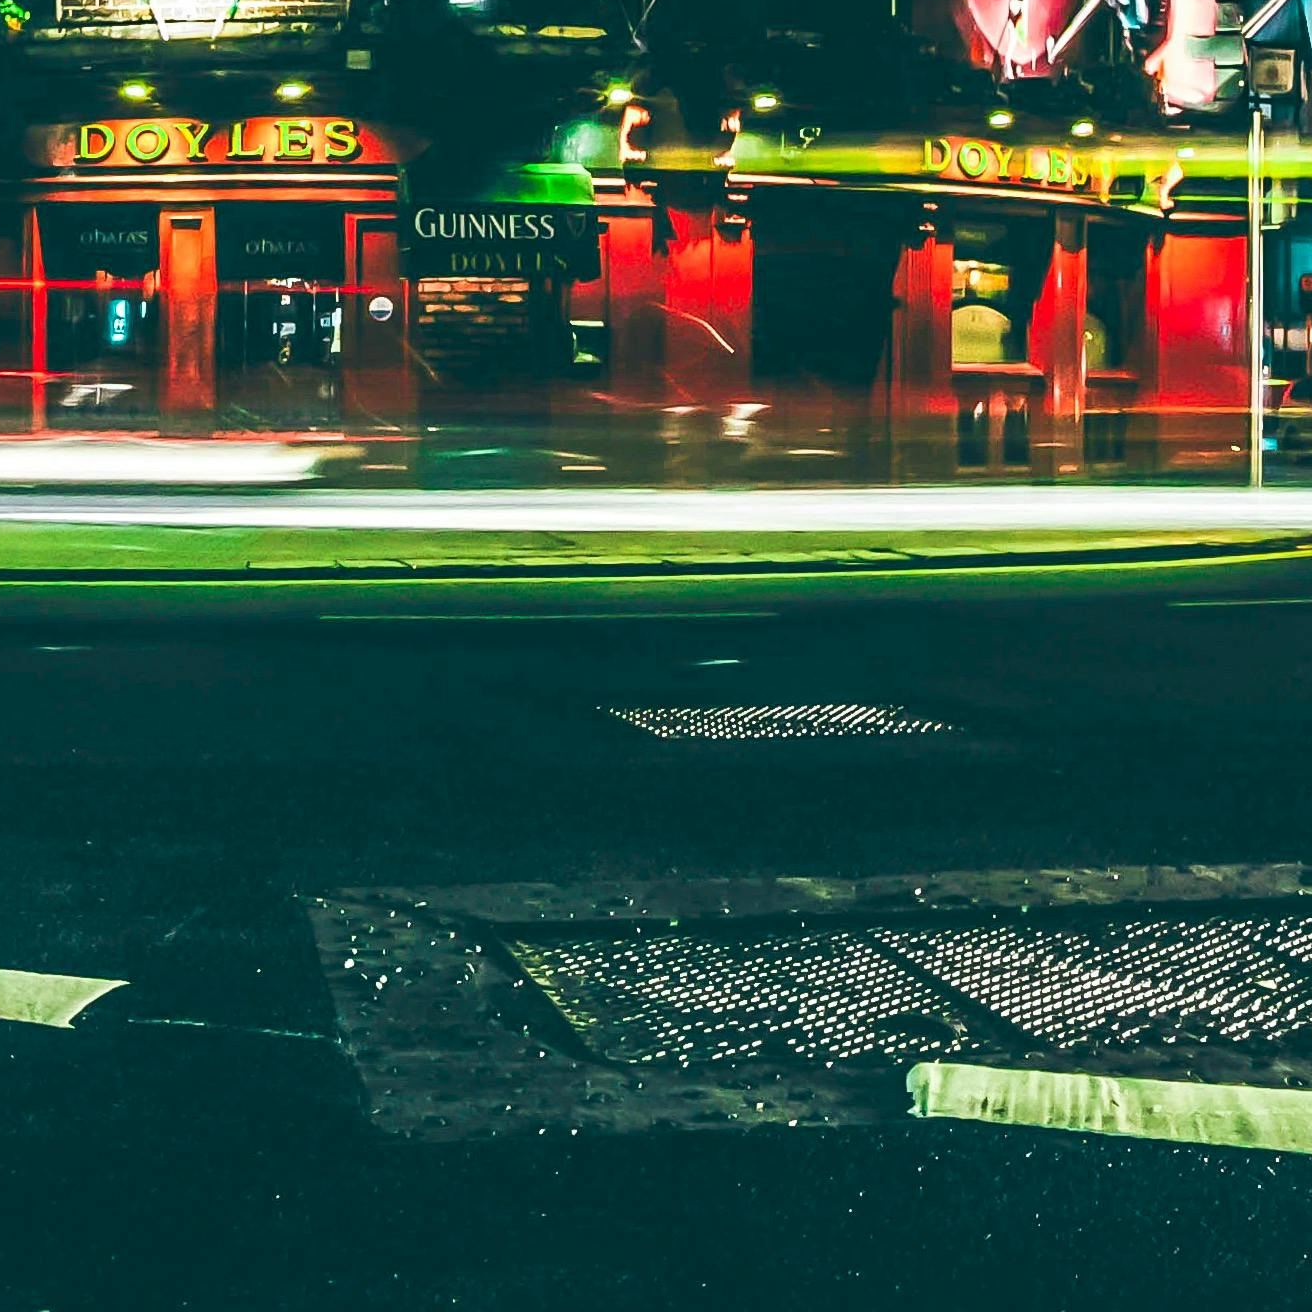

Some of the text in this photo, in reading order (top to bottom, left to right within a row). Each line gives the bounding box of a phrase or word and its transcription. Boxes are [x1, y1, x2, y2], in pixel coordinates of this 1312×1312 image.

[74, 120, 362, 162] DOYLES
[922, 138, 1088, 186] DOYLES
[415, 208, 555, 239] GUINNESS
